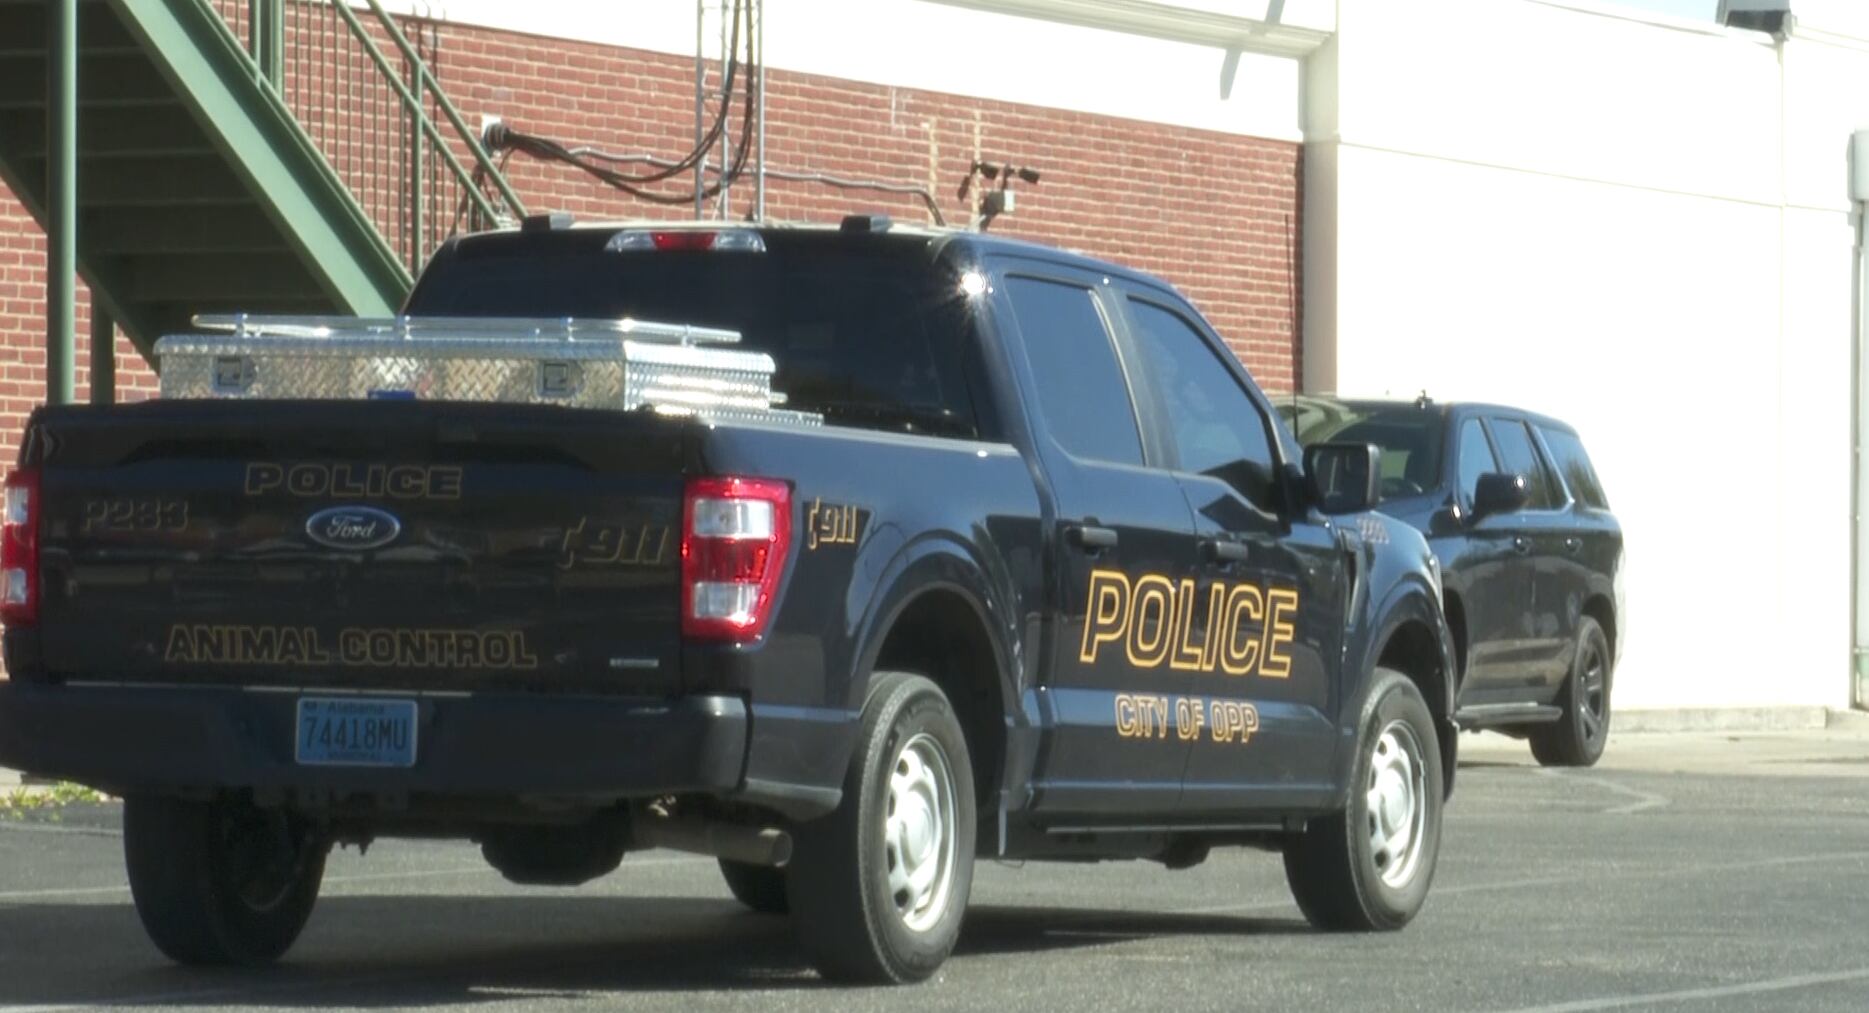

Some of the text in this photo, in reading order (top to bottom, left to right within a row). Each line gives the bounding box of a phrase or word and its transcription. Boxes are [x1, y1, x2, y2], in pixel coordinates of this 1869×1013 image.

[244, 462, 463, 499] POLICE
[326, 515, 377, 540] Ford
[1080, 569, 1299, 678] POLICE
[165, 625, 538, 669] ANIMAL CONTROL
[304, 716, 408, 751] 74418MU
[1115, 693, 1260, 744] CITY OF OPP
